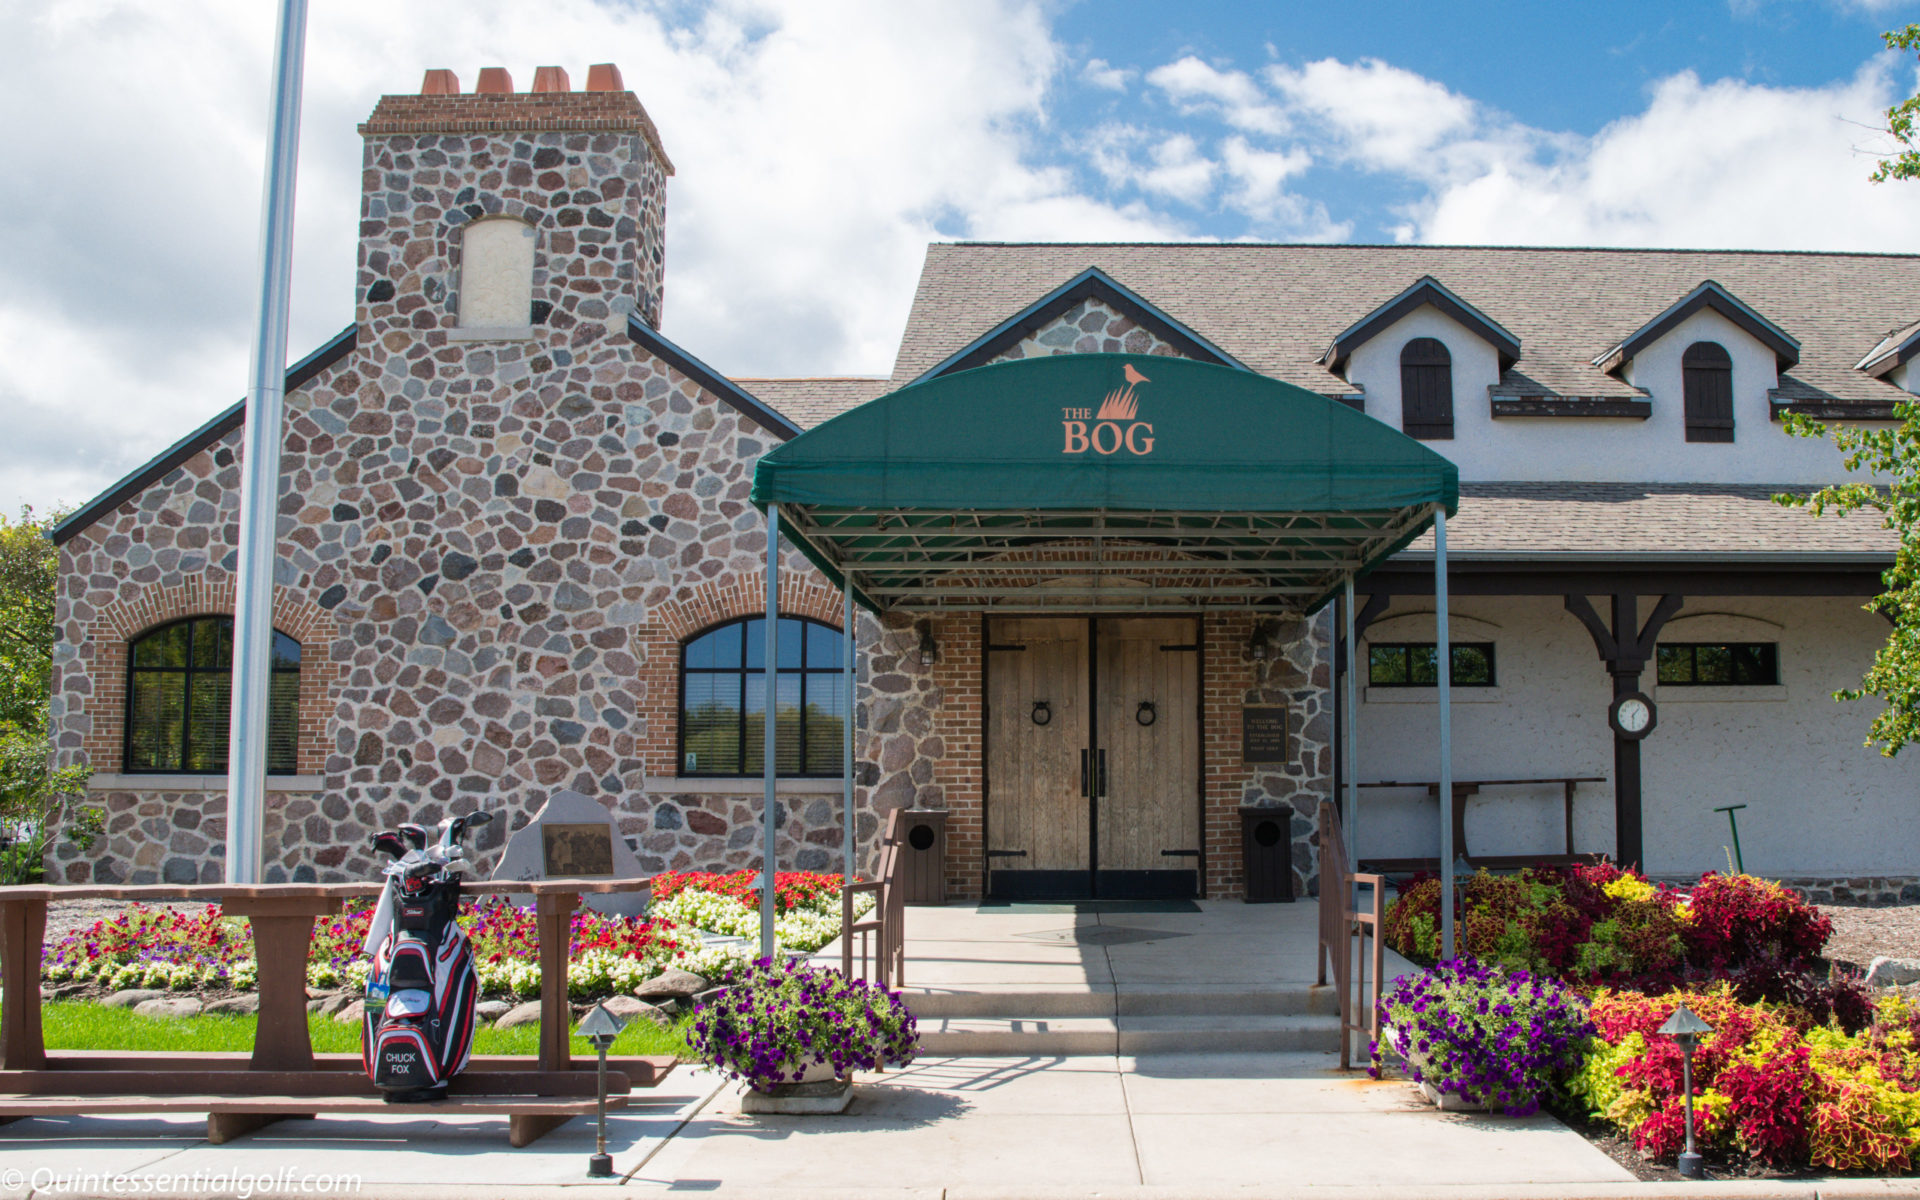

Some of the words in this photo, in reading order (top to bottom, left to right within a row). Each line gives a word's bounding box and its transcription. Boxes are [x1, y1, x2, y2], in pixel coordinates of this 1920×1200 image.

[1062, 407, 1092, 420] THE
[1062, 421, 1156, 456] BOG
[386, 1053, 416, 1063] CHUCK
[391, 1064, 410, 1074] FOX
